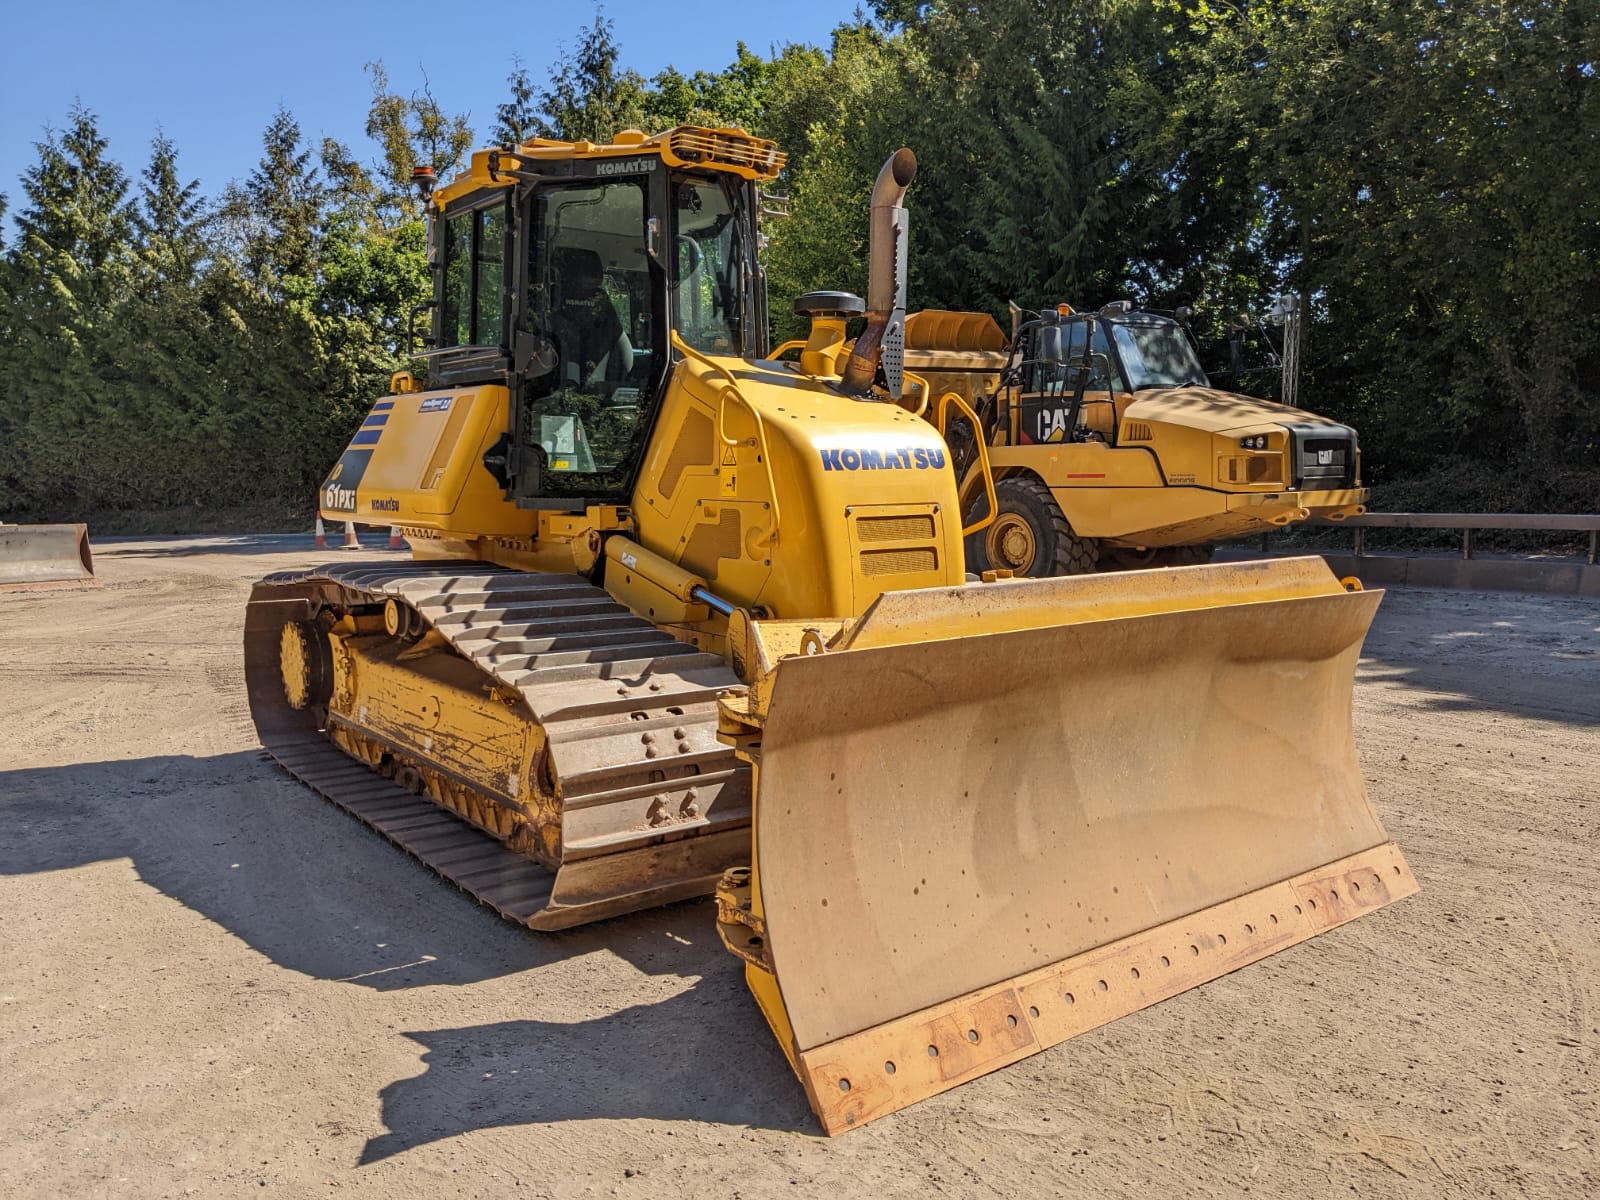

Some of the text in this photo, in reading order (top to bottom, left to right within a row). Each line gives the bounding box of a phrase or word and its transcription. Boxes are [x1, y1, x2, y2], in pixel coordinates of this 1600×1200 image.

[596, 158, 657, 175] KOMATSU
[1037, 408, 1071, 443] CA
[820, 446, 946, 471] KOMATSU
[326, 483, 356, 510] 61PXi
[372, 496, 400, 512] KOMATSU
